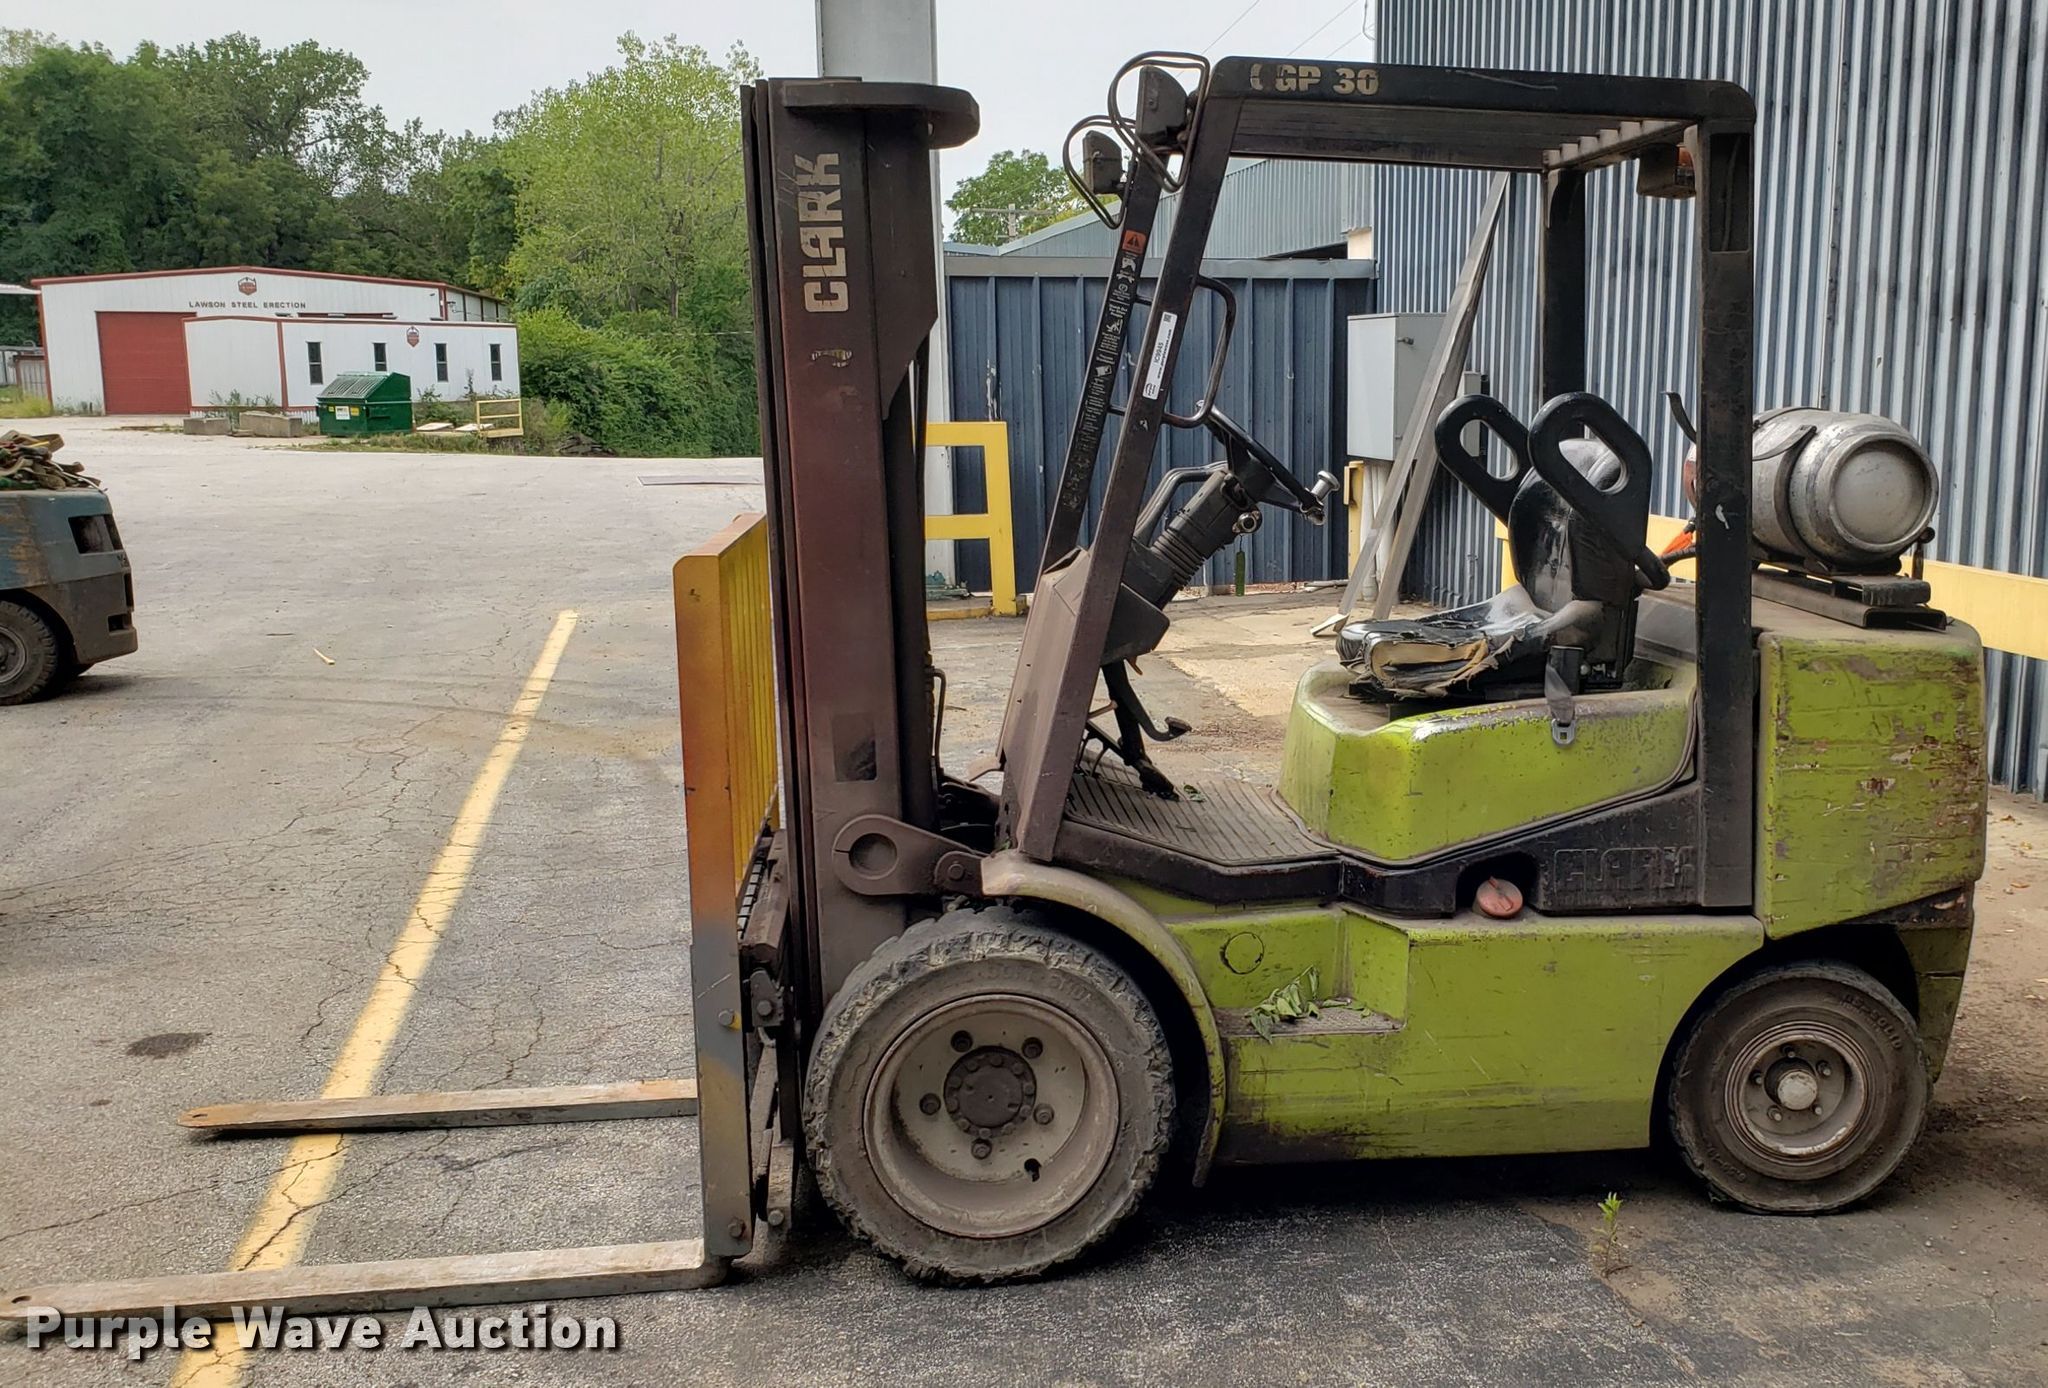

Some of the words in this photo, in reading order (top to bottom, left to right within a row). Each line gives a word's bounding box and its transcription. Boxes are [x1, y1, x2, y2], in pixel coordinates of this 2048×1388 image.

[1332, 67, 1379, 95] 30
[794, 153, 849, 313] CLARK
[231, 301, 258, 309] STEEL
